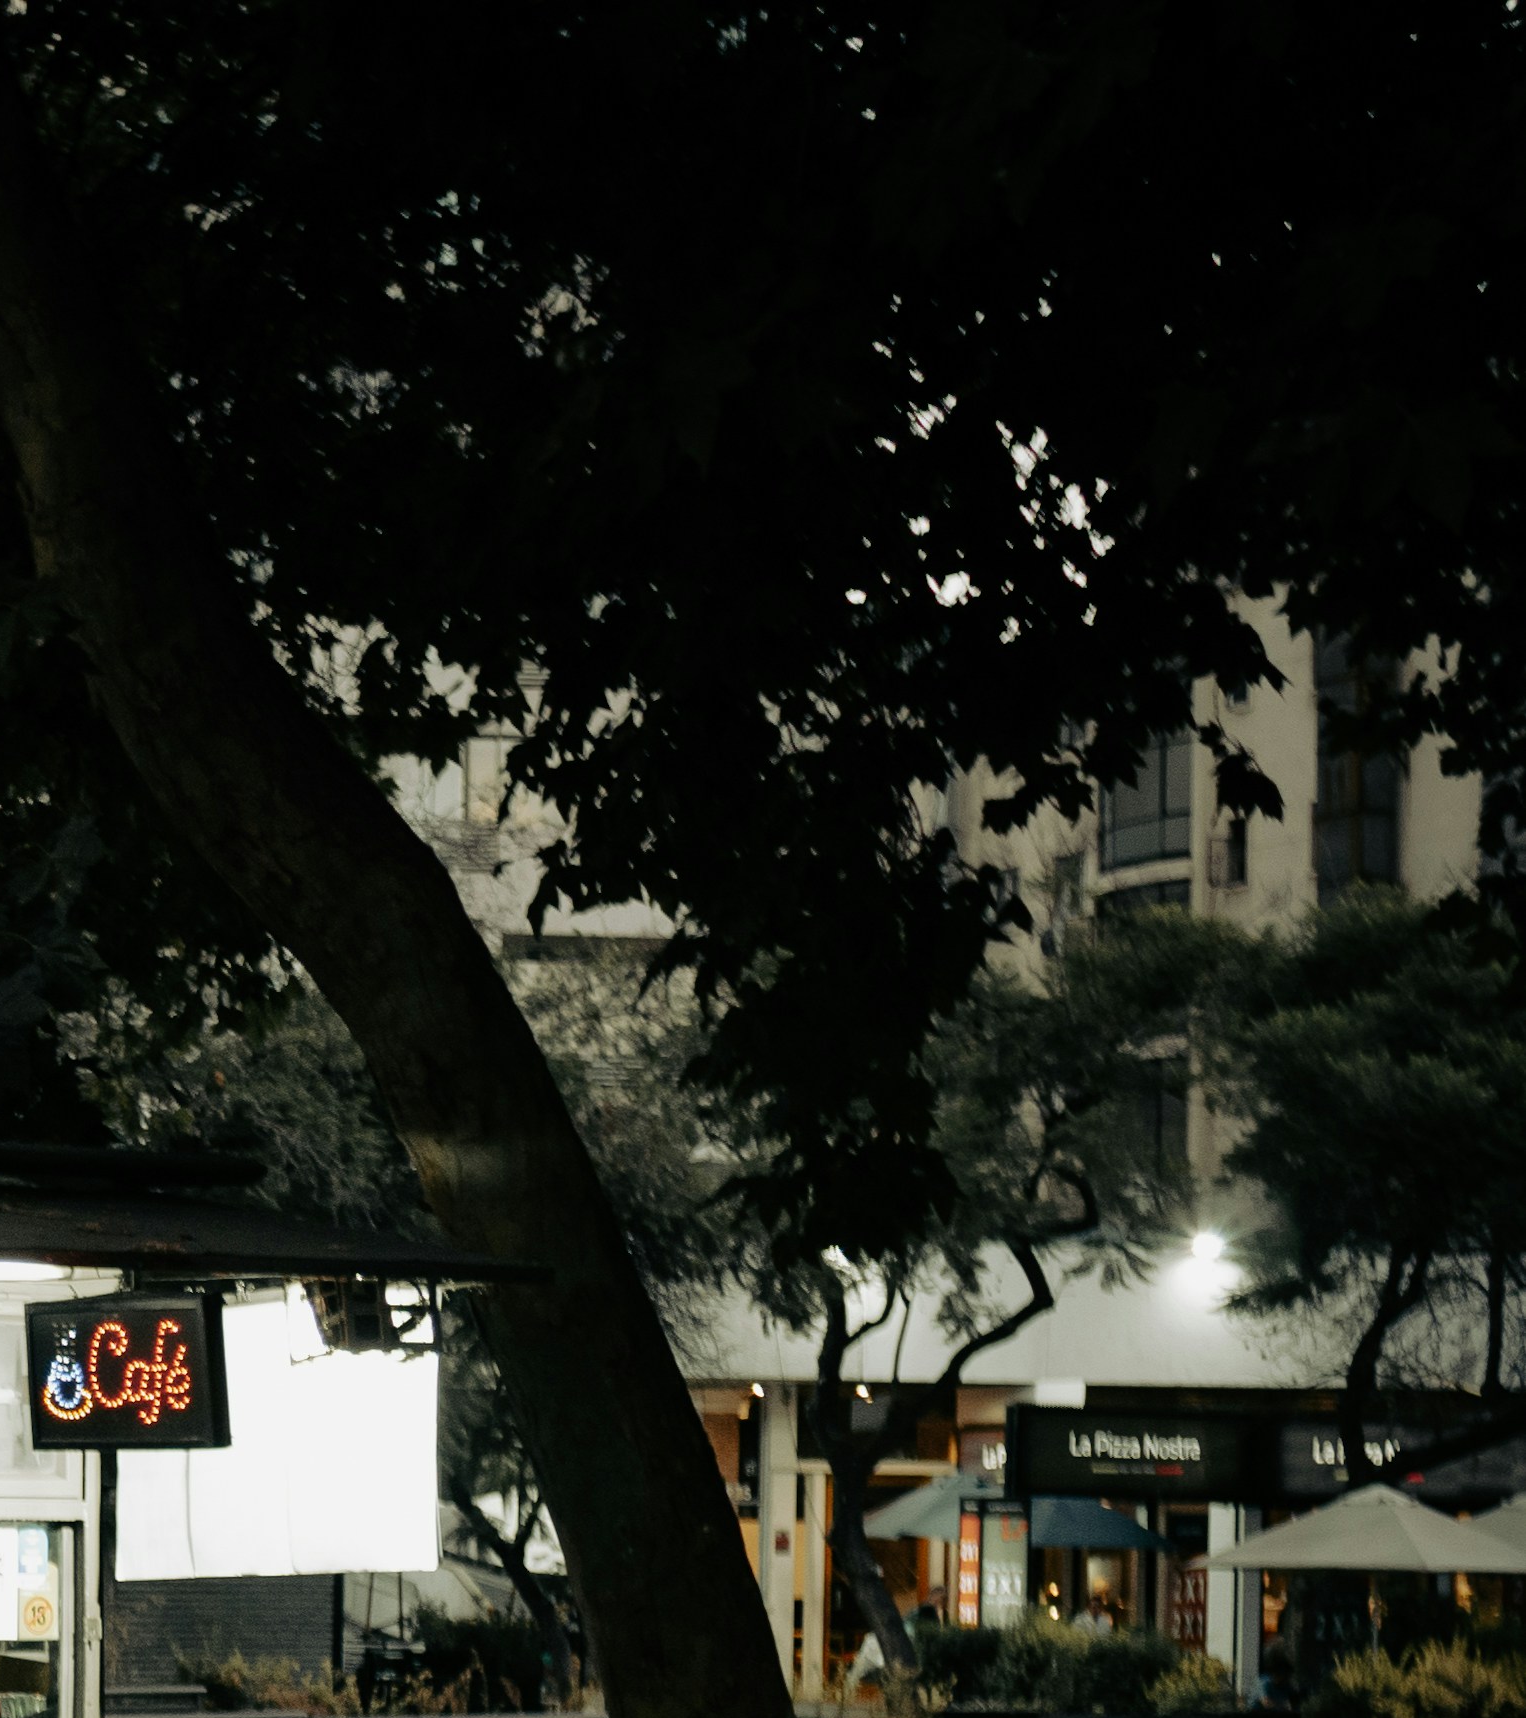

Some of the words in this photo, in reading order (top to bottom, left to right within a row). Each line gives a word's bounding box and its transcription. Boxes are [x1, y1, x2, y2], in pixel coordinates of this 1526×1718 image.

[89, 1318, 191, 1425] Café
[1068, 1429, 1092, 1459] La
[1093, 1429, 1141, 1461] Pizza
[1143, 1432, 1201, 1462] Nostra
